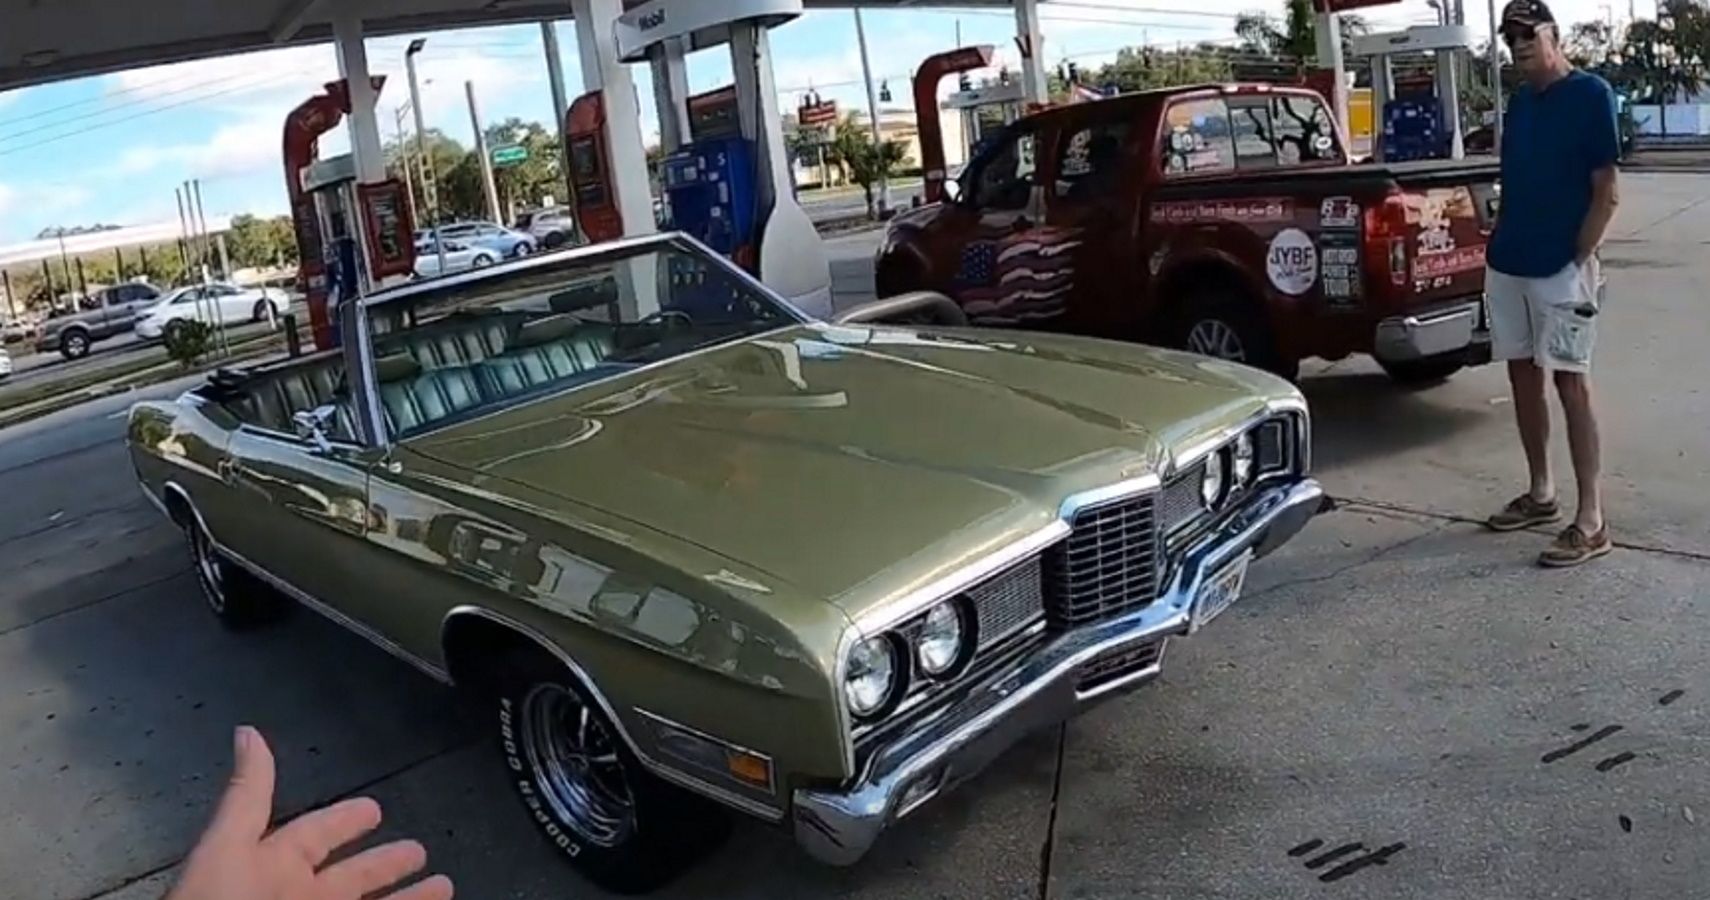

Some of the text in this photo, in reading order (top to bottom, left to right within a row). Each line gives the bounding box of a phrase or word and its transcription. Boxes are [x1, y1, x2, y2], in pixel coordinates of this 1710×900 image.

[639, 8, 665, 32] Mobil
[1269, 246, 1313, 266] JYBF
[499, 697, 581, 858] COOPER COBRA
